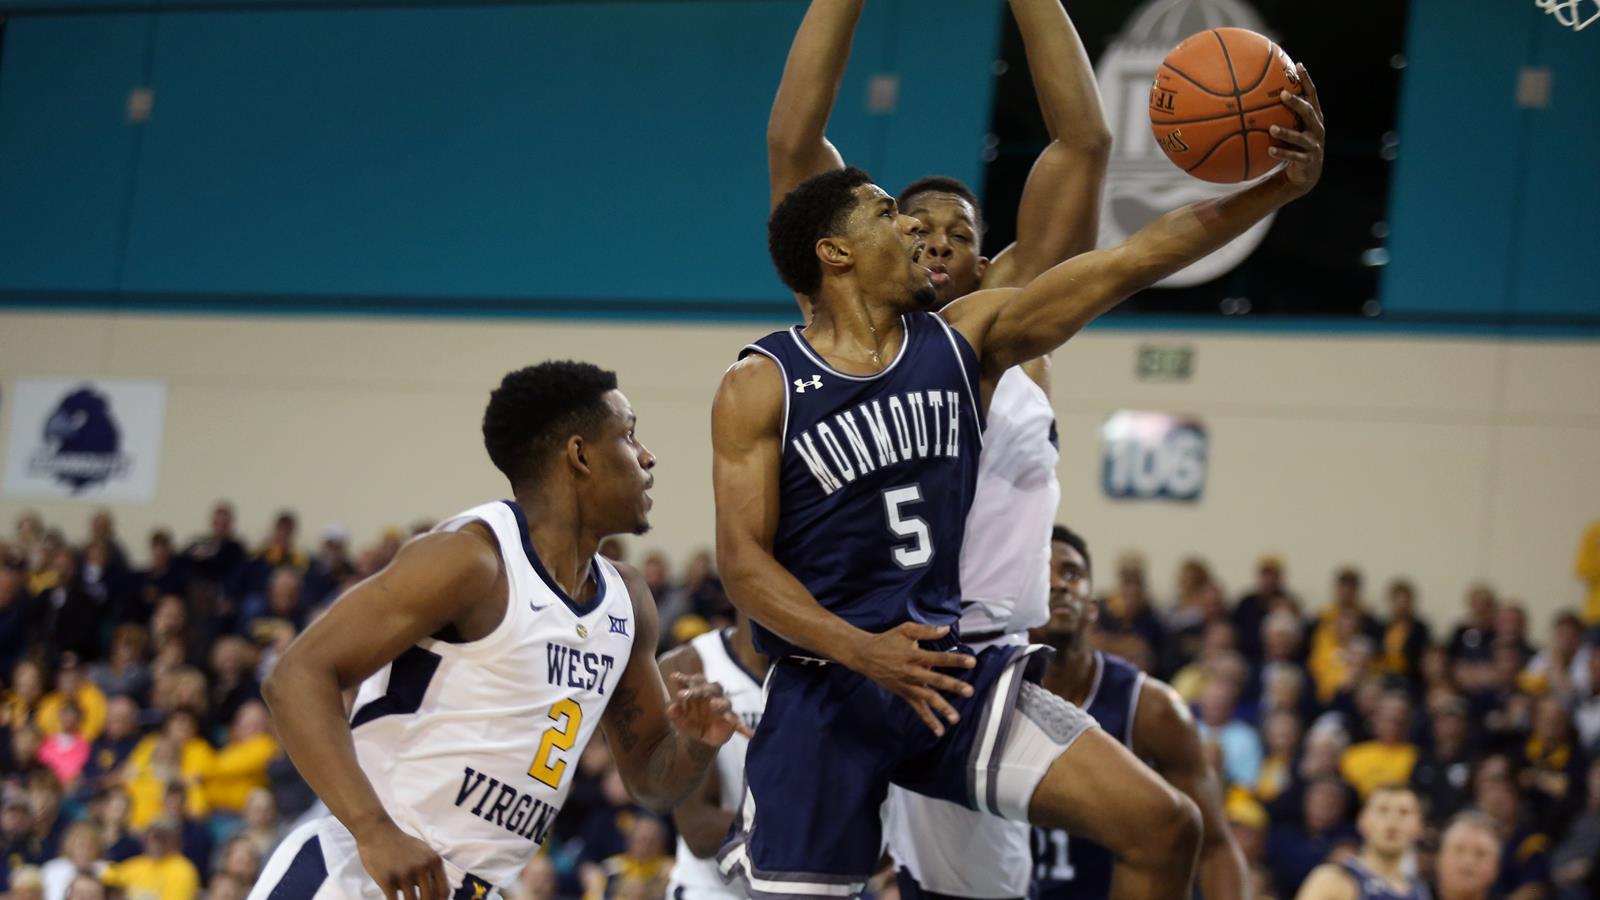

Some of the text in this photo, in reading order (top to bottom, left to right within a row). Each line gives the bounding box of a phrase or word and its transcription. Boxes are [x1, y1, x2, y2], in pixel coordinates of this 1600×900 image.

[793, 390, 959, 495] MONMOUTH
[1105, 424, 1204, 493] 106
[882, 484, 935, 569] 5
[547, 643, 614, 695] WEST
[527, 698, 583, 790] 2
[454, 767, 558, 845] VIRGIN
